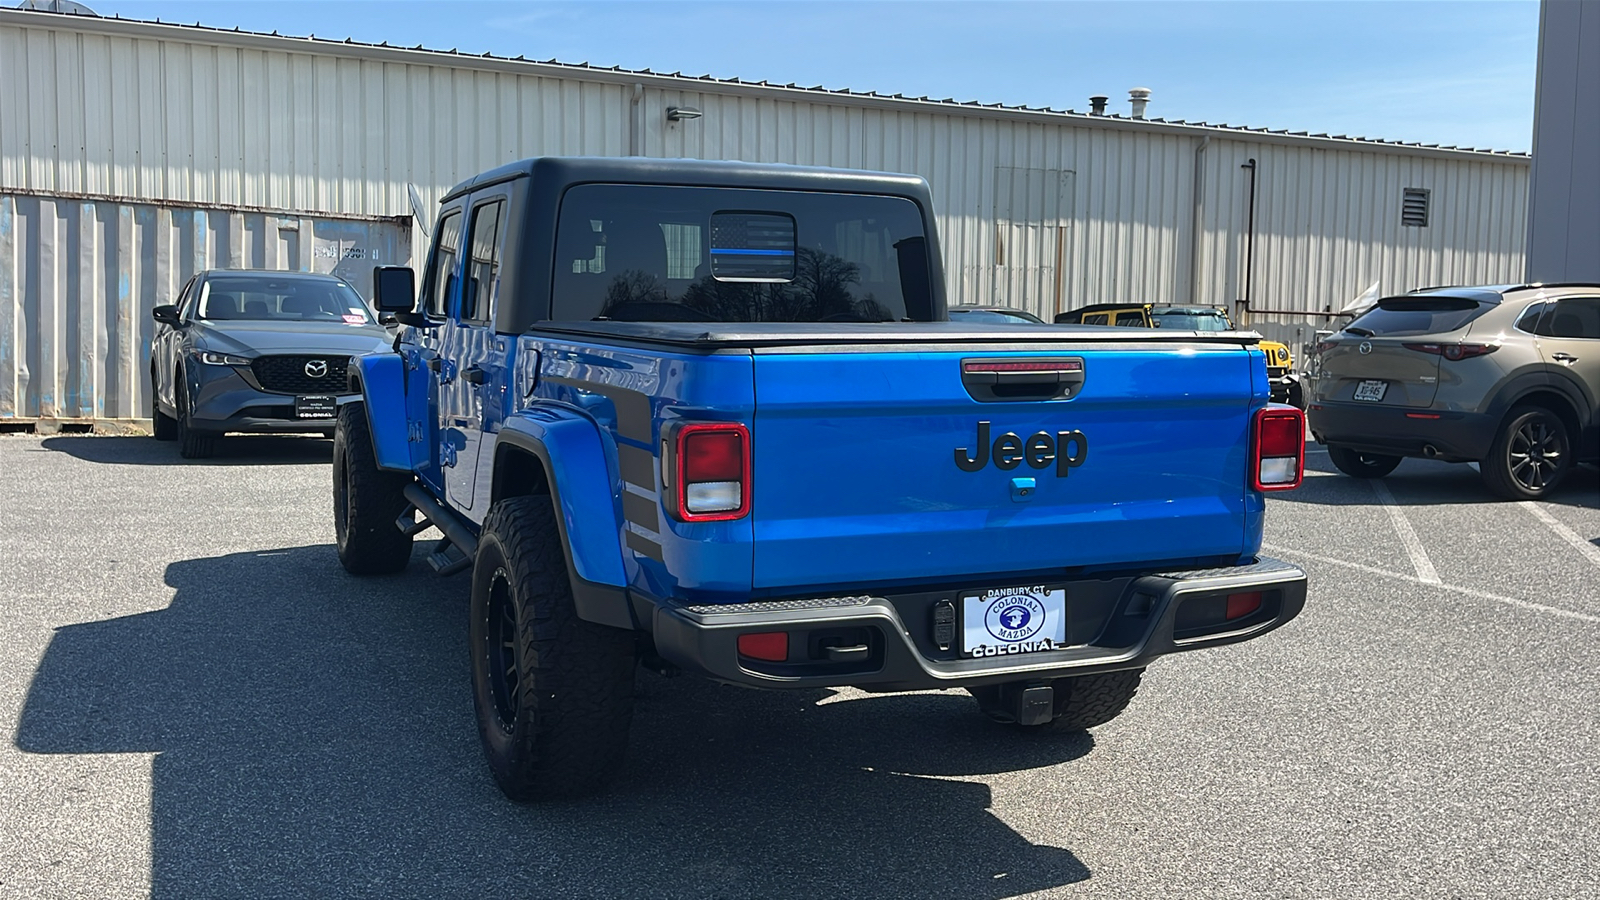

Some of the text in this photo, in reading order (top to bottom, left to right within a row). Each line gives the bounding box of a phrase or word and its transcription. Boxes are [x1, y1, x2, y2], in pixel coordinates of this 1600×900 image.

[954, 420, 1088, 478] Jeep
[1033, 585, 1046, 595] CT
[992, 596, 1038, 614] COLONIAL
[998, 626, 1033, 639] MAZDA
[972, 640, 1060, 658] COLONIAL
